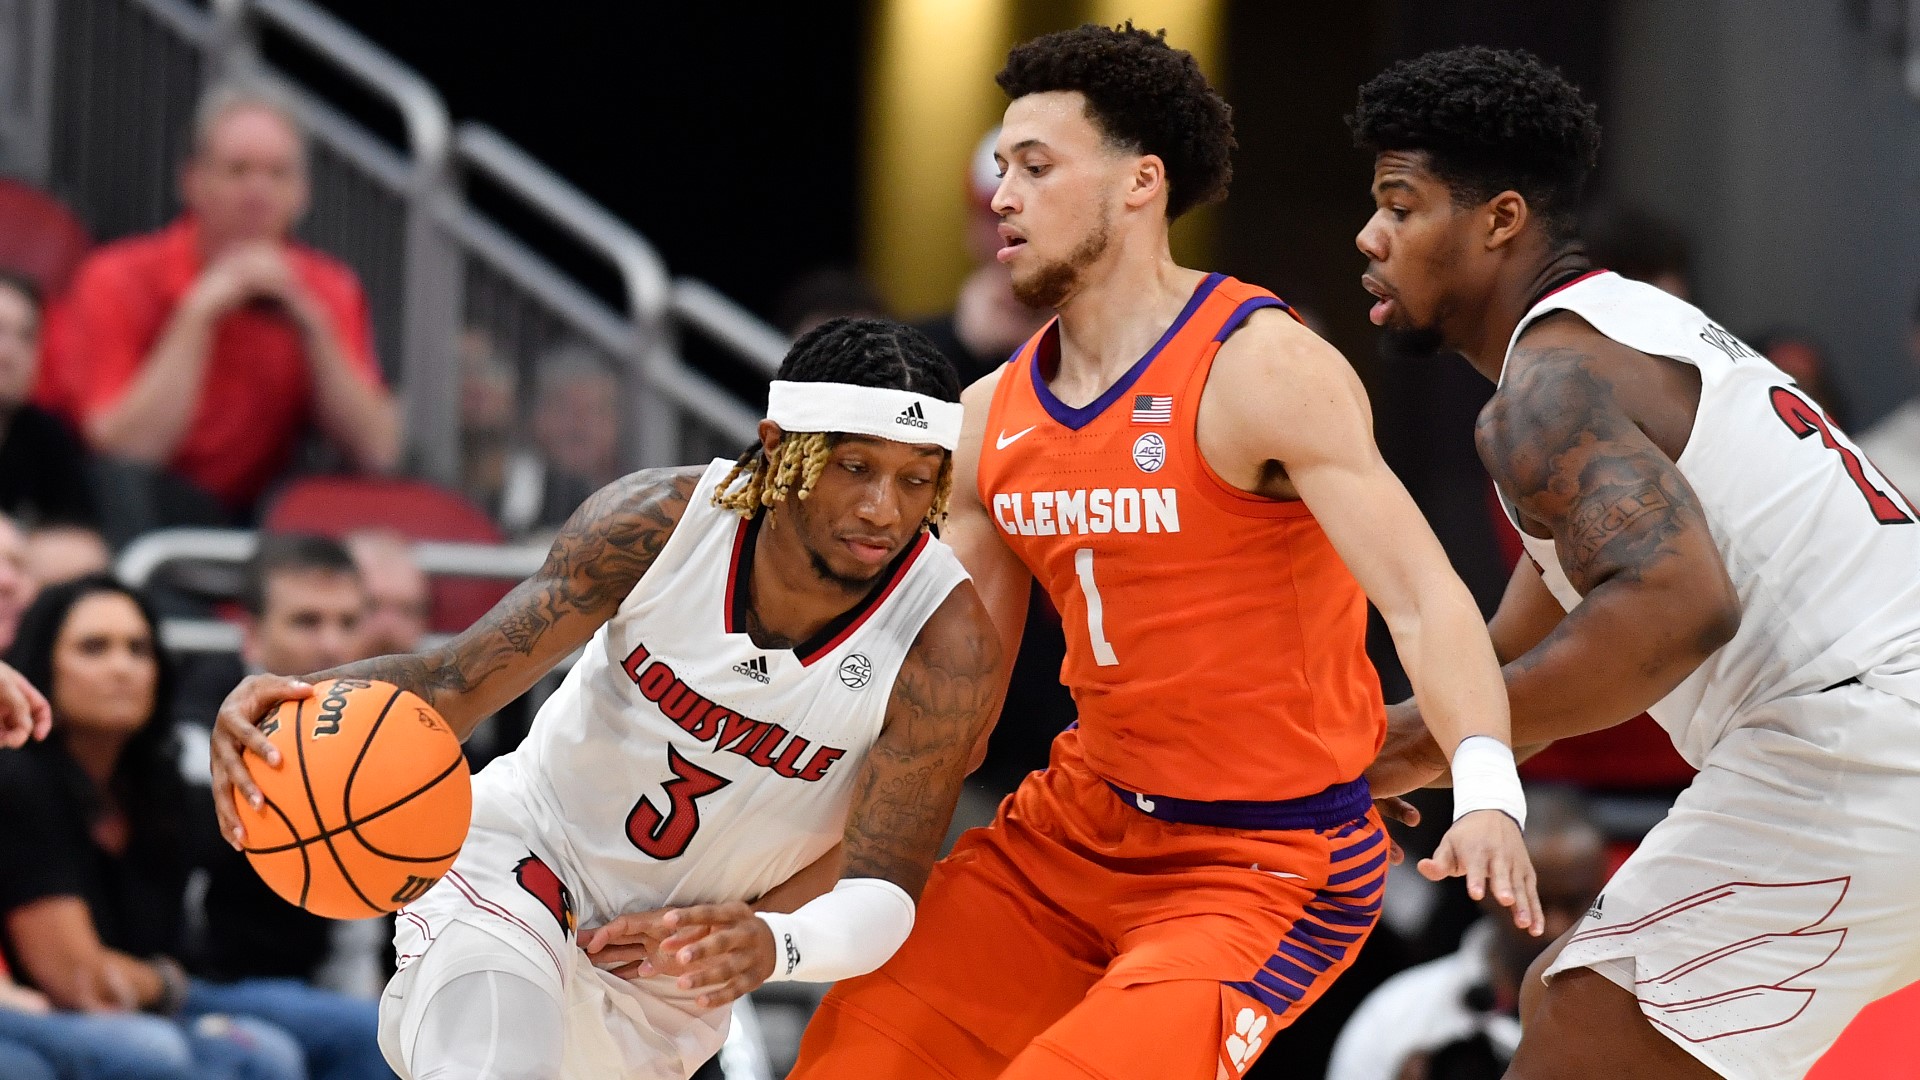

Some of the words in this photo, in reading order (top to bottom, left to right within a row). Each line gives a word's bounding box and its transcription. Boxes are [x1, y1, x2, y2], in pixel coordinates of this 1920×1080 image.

[895, 414, 928, 430] adidas
[993, 488, 1181, 536] CLEMSON
[1074, 548, 1120, 667] 1
[619, 642, 847, 782] LOUISVILLE
[732, 664, 772, 685] adidas
[625, 741, 733, 860] 3
